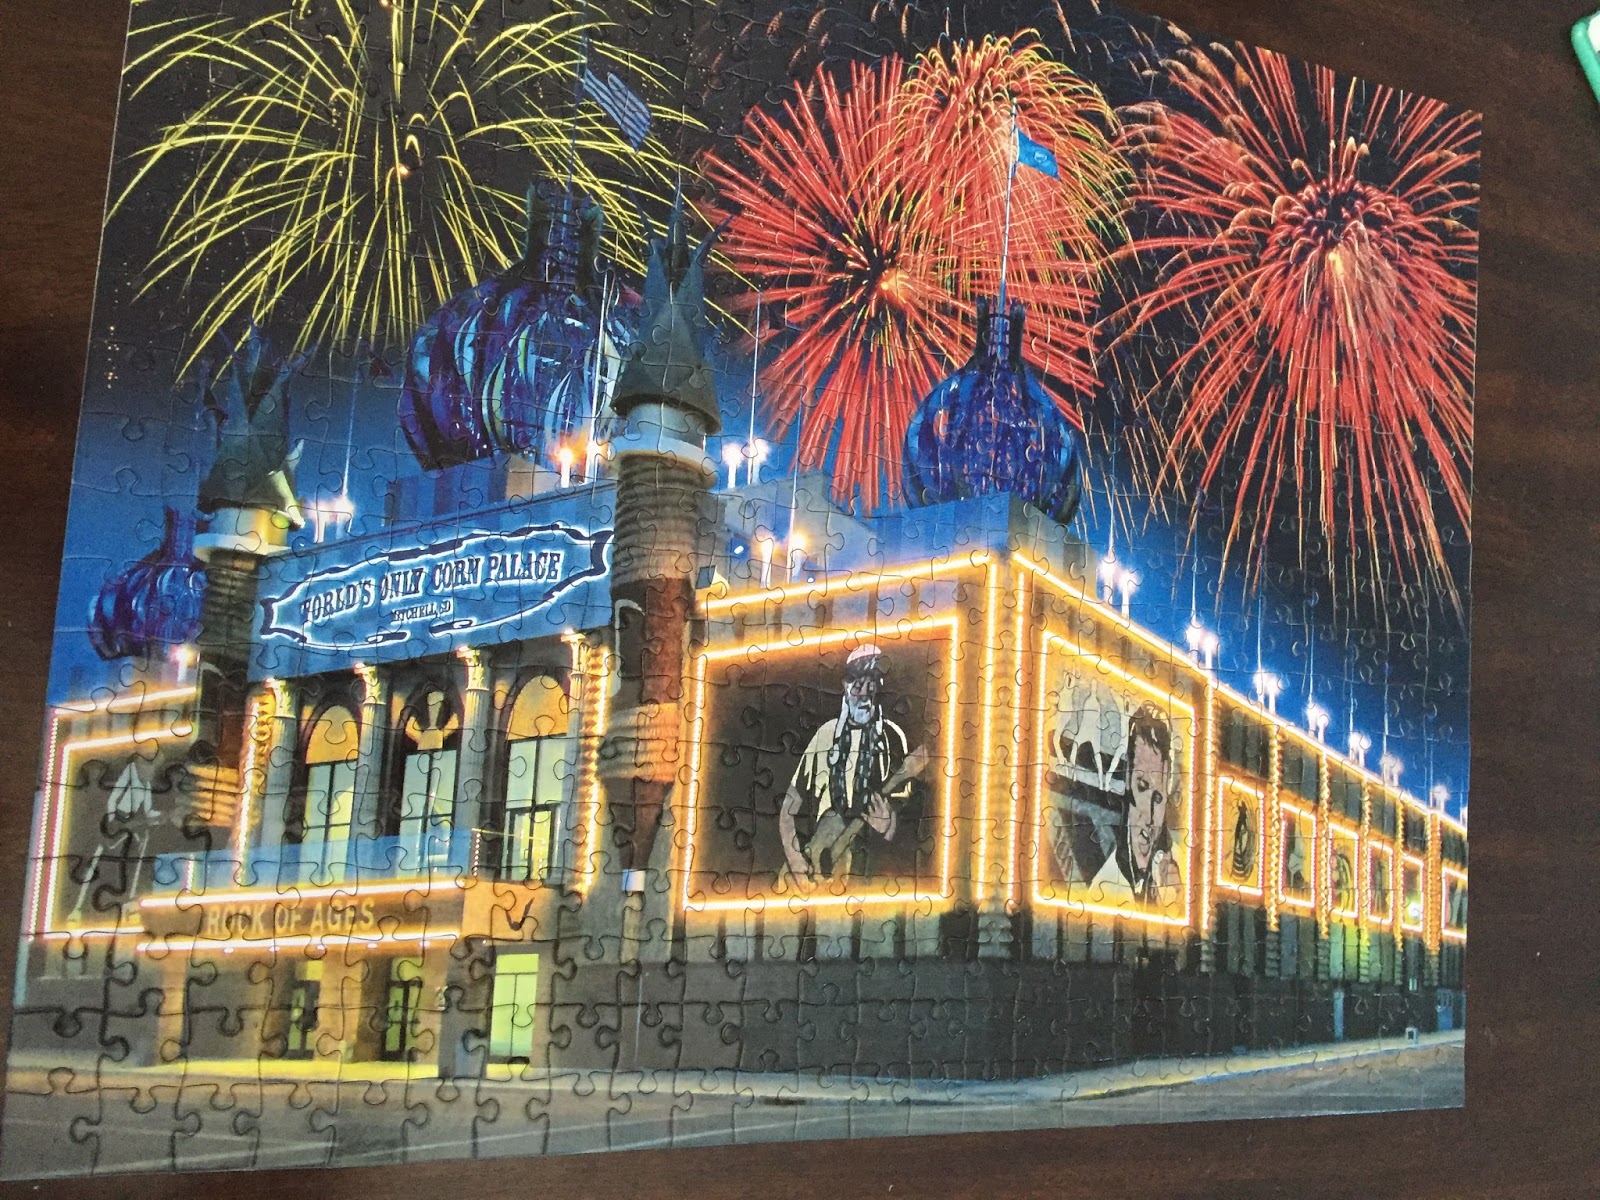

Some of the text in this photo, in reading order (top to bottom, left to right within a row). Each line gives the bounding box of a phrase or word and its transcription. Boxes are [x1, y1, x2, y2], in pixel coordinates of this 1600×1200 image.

[380, 567, 424, 600] ONLY
[434, 558, 481, 590] CORN
[488, 552, 561, 581] PALACE
[206, 897, 374, 936] ROCK OF AGES
